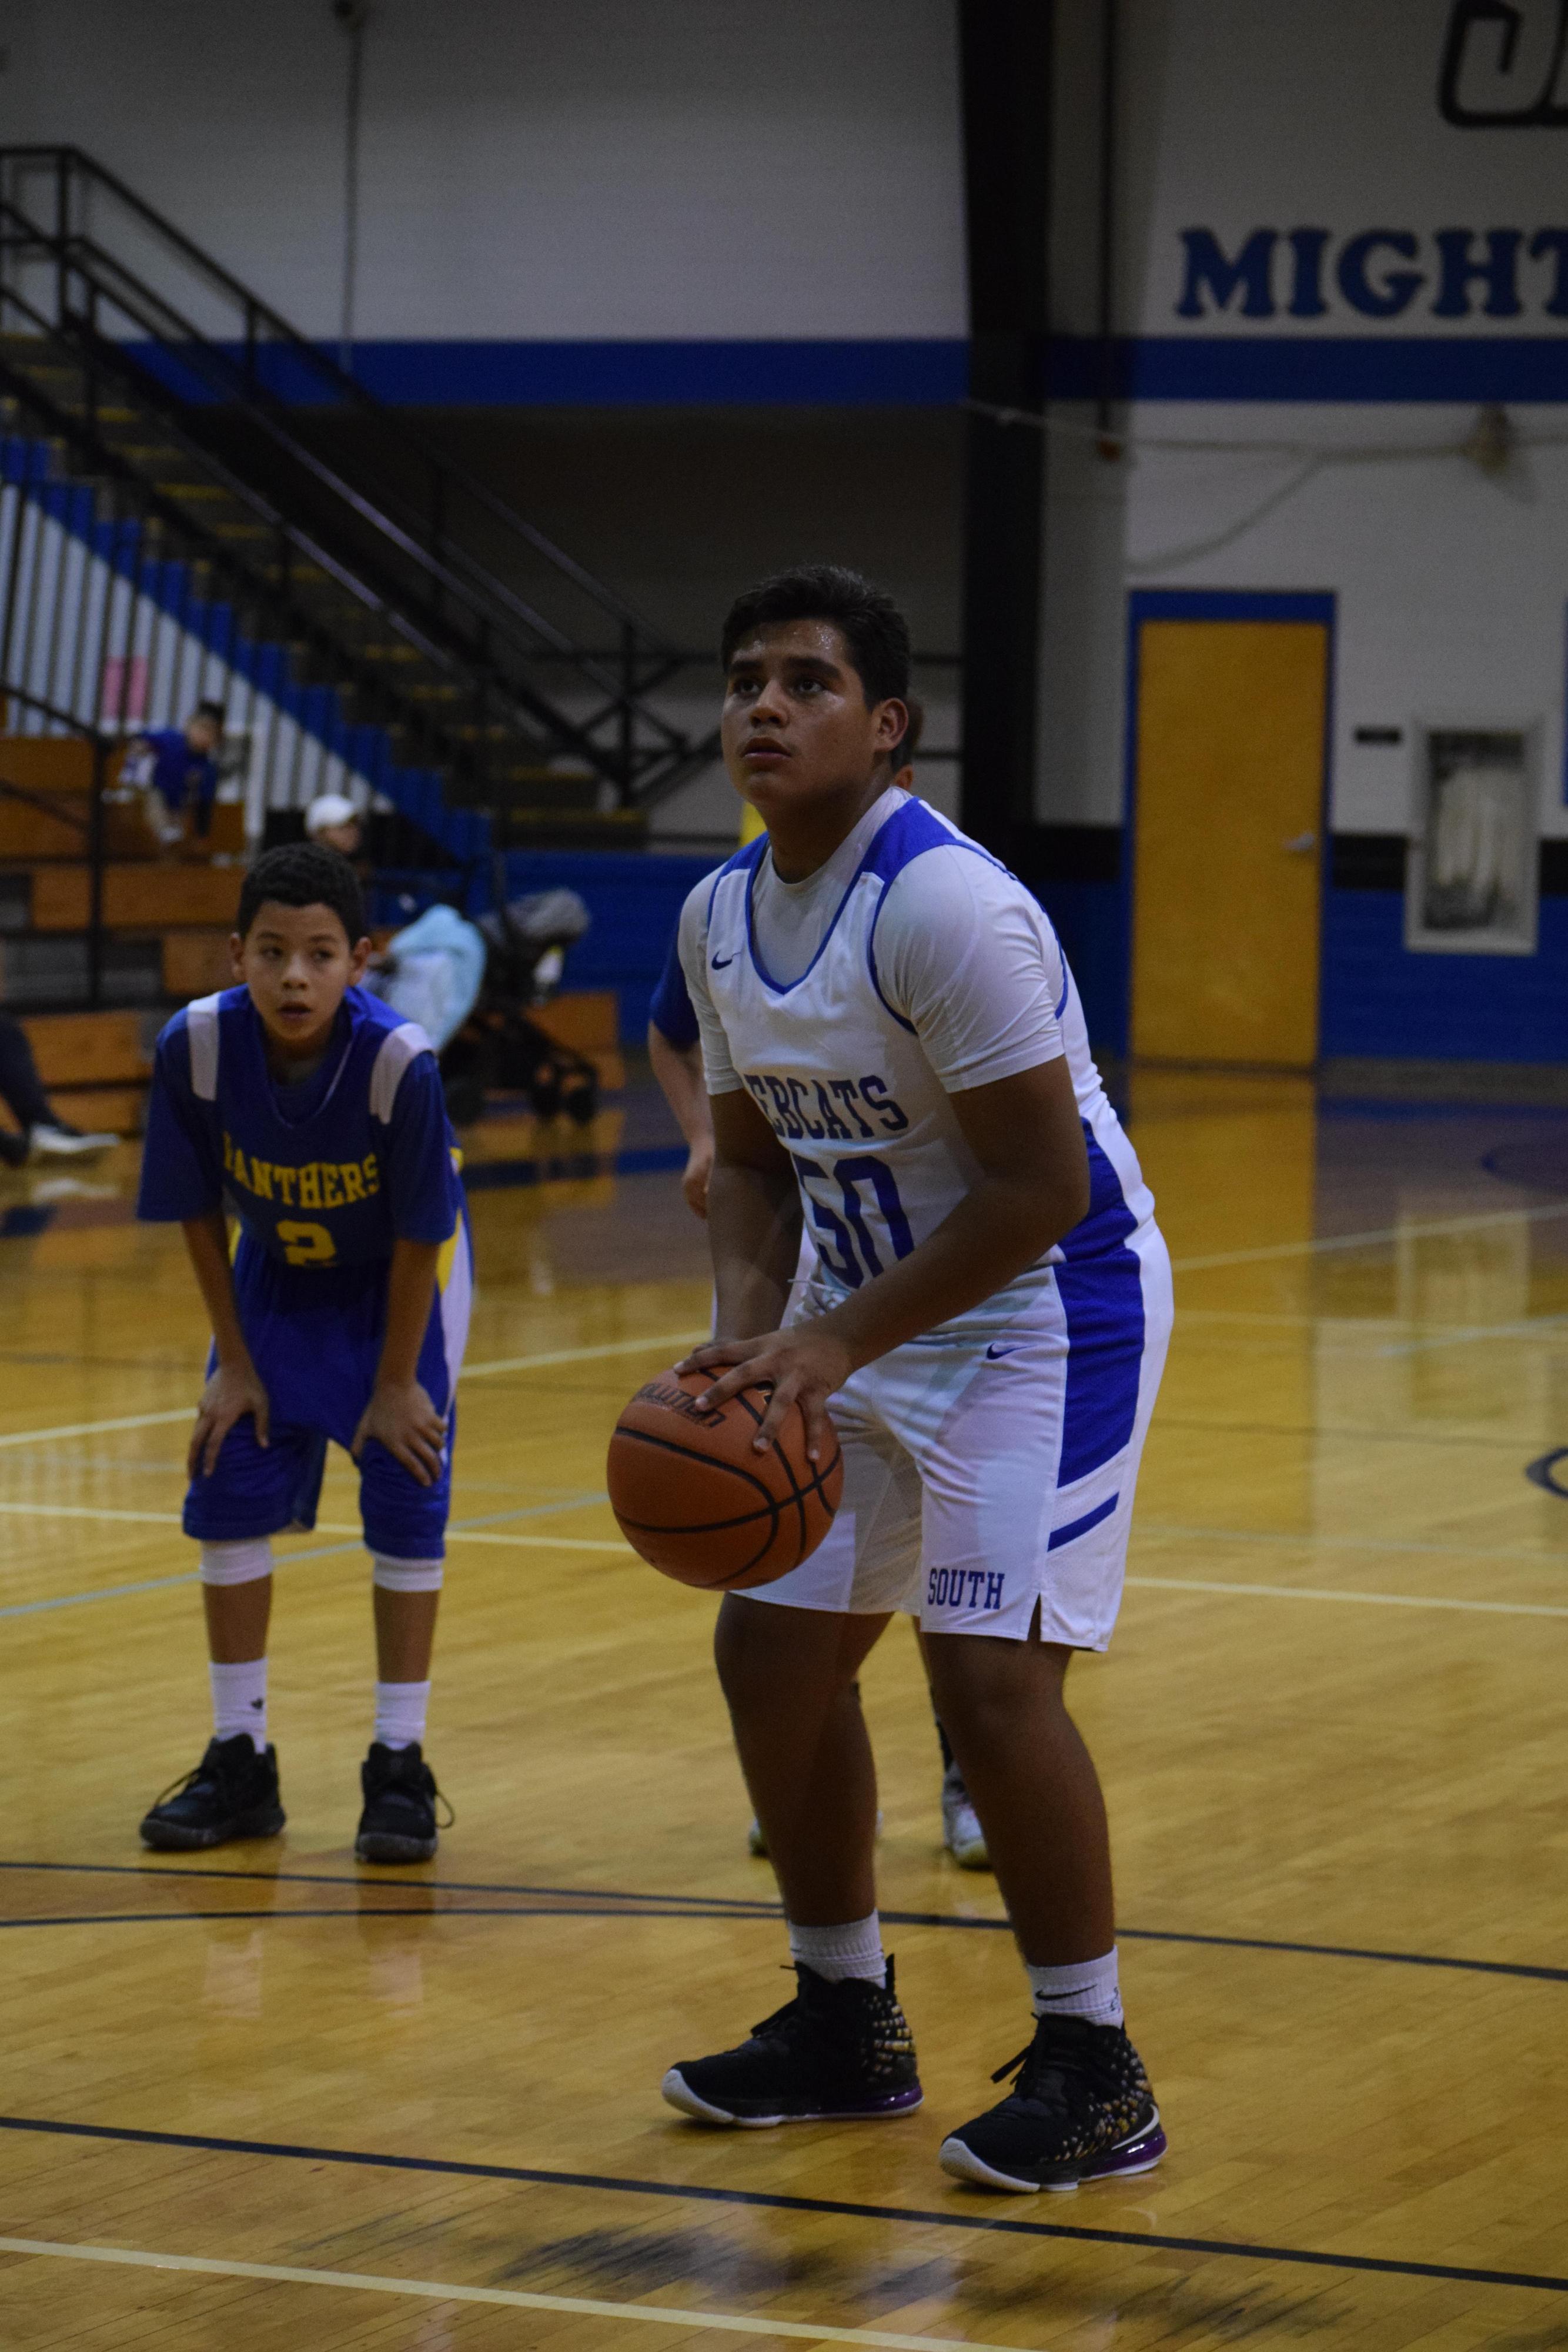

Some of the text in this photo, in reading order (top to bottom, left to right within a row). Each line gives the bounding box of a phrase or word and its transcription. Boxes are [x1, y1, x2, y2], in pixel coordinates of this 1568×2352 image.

[276, 1220, 337, 1267] 2
[792, 1154, 915, 1289] 50
[928, 1568, 1005, 1609] SOUTH
